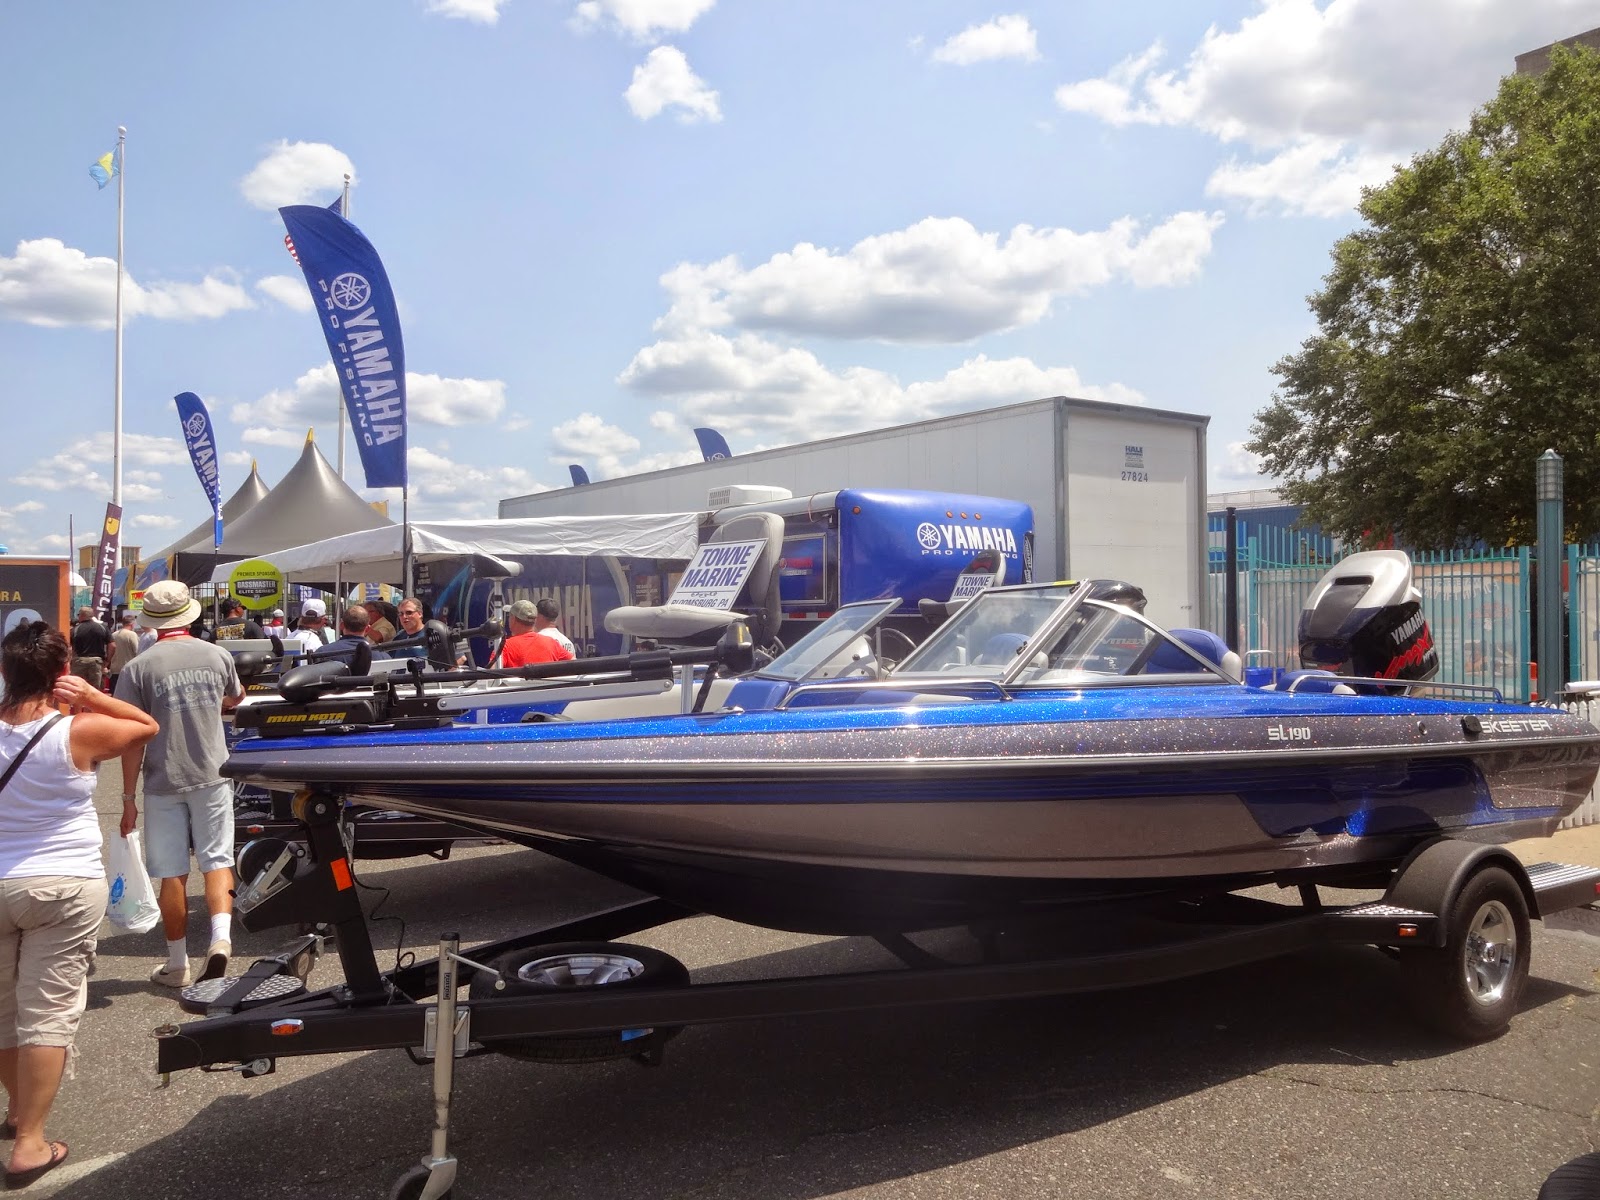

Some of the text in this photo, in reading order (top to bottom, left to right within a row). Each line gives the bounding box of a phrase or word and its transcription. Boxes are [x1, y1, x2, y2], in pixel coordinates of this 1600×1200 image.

[318, 279, 374, 447] PRO FISHING
[343, 306, 403, 446] YAMAHA
[193, 432, 218, 487] YAM
[1121, 471, 1148, 482] 27824
[939, 524, 1018, 553] YAMAHA
[697, 544, 756, 567] TOWNE
[962, 549, 1018, 559] FING
[237, 580, 276, 588] BASSMASTER
[680, 566, 747, 588] MARINE
[961, 576, 991, 587] TOWNE
[717, 598, 730, 608] PA
[1390, 608, 1427, 646] YAMAHA
[308, 712, 347, 721] KOTA
[1480, 719, 1553, 734] SKEETER
